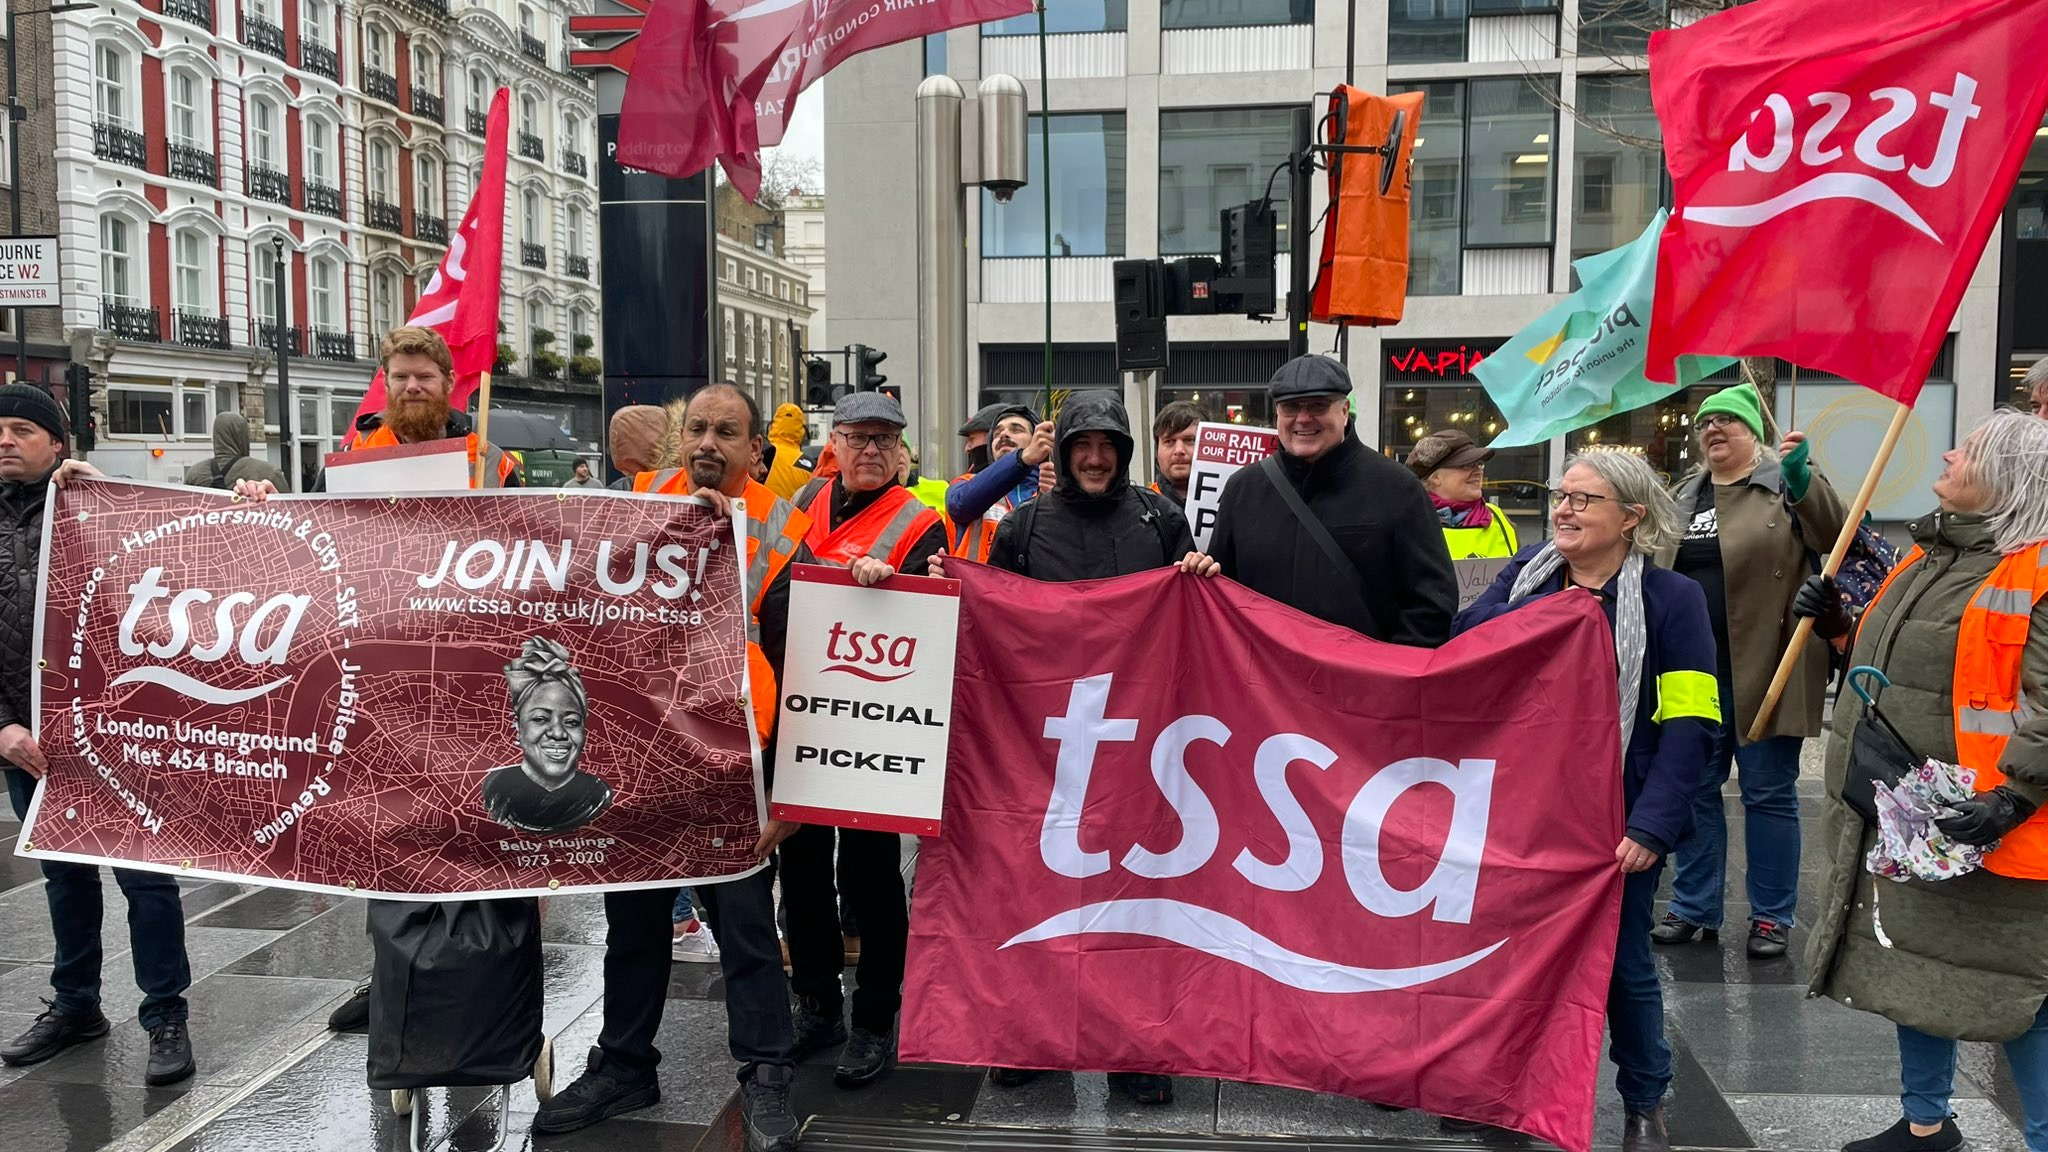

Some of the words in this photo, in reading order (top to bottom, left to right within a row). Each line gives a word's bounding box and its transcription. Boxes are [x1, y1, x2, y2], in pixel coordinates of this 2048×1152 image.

[607, 141, 692, 158] Pddington
[18, 263, 40, 279] W2
[1202, 446, 1224, 457] OUR
[1204, 431, 1226, 442] OUR
[1228, 433, 1265, 451] RAIL
[1194, 471, 1221, 503] F
[121, 508, 294, 554] Hammersmith
[294, 519, 313, 541] &
[310, 532, 342, 572] City
[416, 539, 572, 592] JOIN
[595, 540, 709, 602] US!
[69, 567, 105, 669] Bakerloo
[117, 566, 313, 665] tssa
[336, 586, 360, 629] SRT
[409, 595, 701, 625] www.tssa.org.uk/join-tssa
[826, 621, 917, 667] tssa
[329, 658, 361, 755] Jubilee
[785, 694, 944, 727] OFFICIAL
[97, 713, 169, 740] London
[175, 720, 318, 755] Underground
[71, 696, 164, 835] Metropolitan
[122, 742, 162, 767] Met
[167, 748, 208, 771] 454
[214, 751, 287, 779] Branch
[795, 745, 925, 775] PICKET
[253, 775, 332, 844] Revenue
[1039, 671, 1496, 925] tssa
[499, 840, 542, 852] Belly
[548, 837, 615, 850] Mujinga
[517, 854, 550, 867] 1973
[566, 851, 605, 864] 2020
